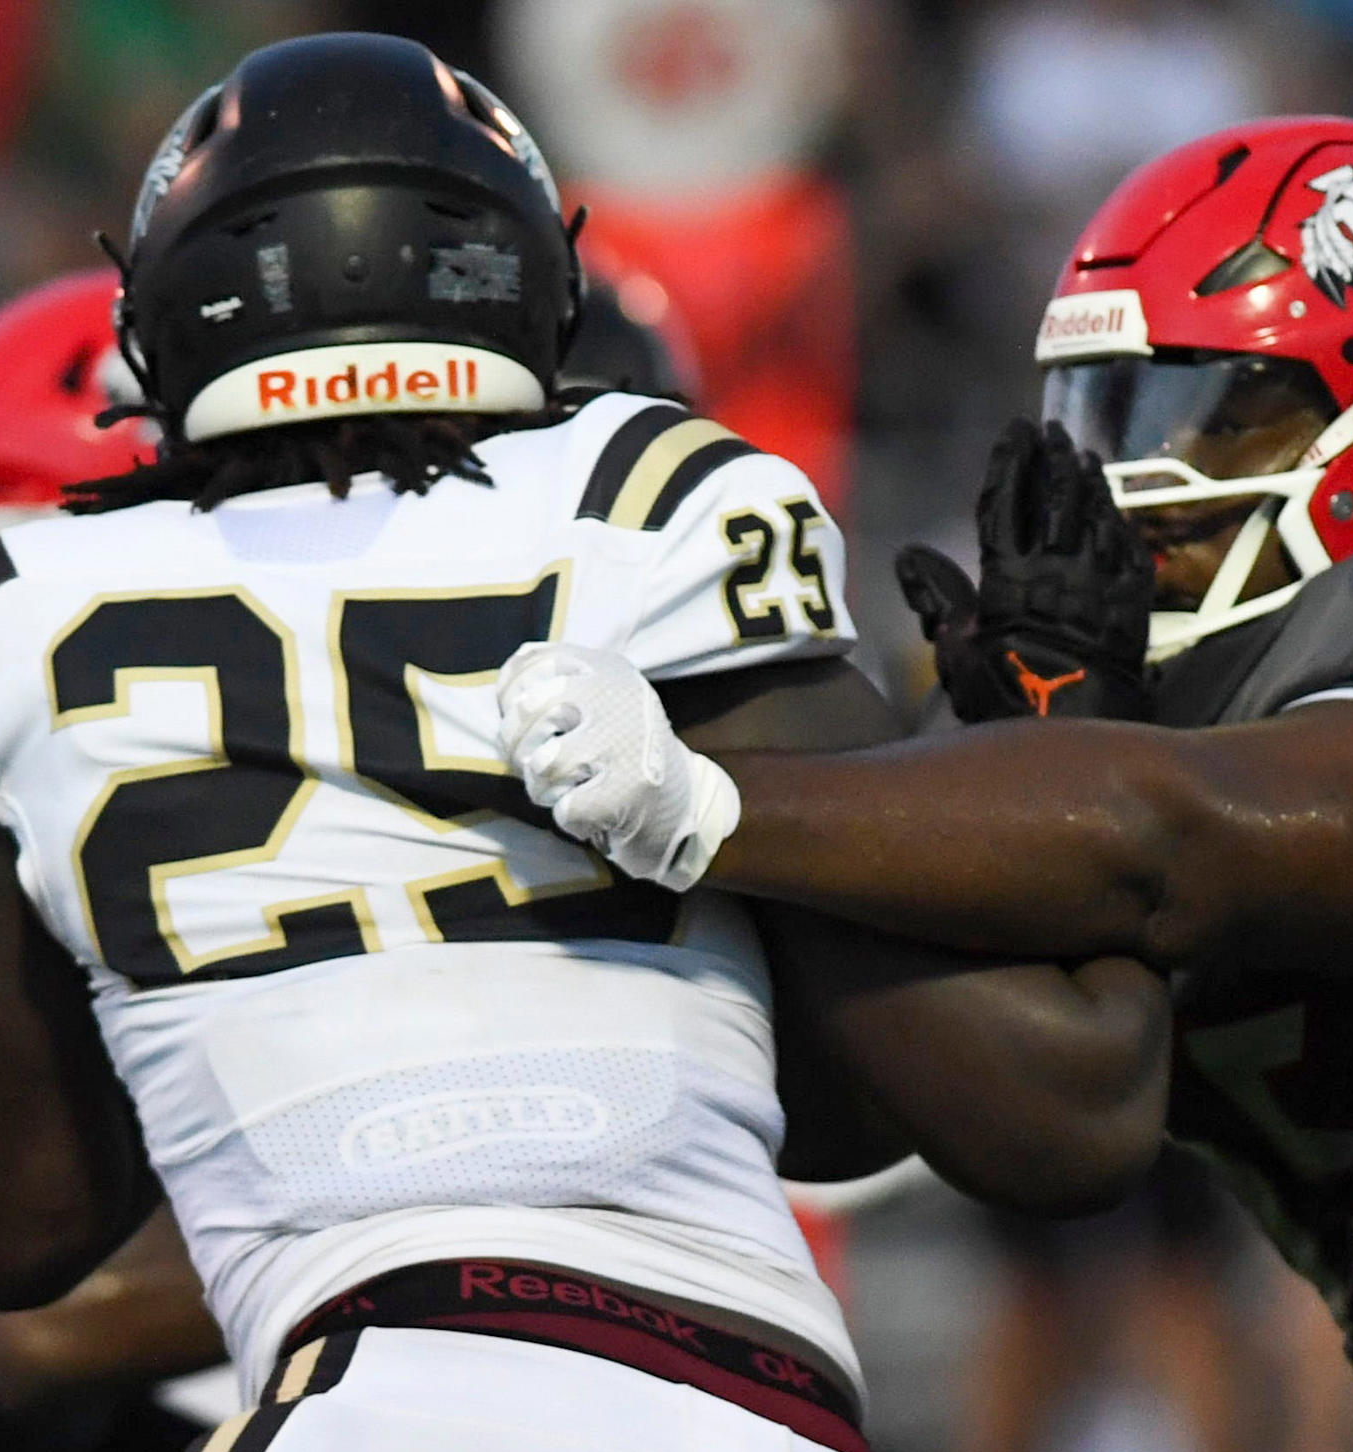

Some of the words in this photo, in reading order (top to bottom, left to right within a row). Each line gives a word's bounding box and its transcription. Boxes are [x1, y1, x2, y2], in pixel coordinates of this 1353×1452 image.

[256, 359, 478, 412] Riddell
[718, 494, 838, 645] 25
[48, 558, 684, 988] 25
[458, 1261, 710, 1352] Reebok
